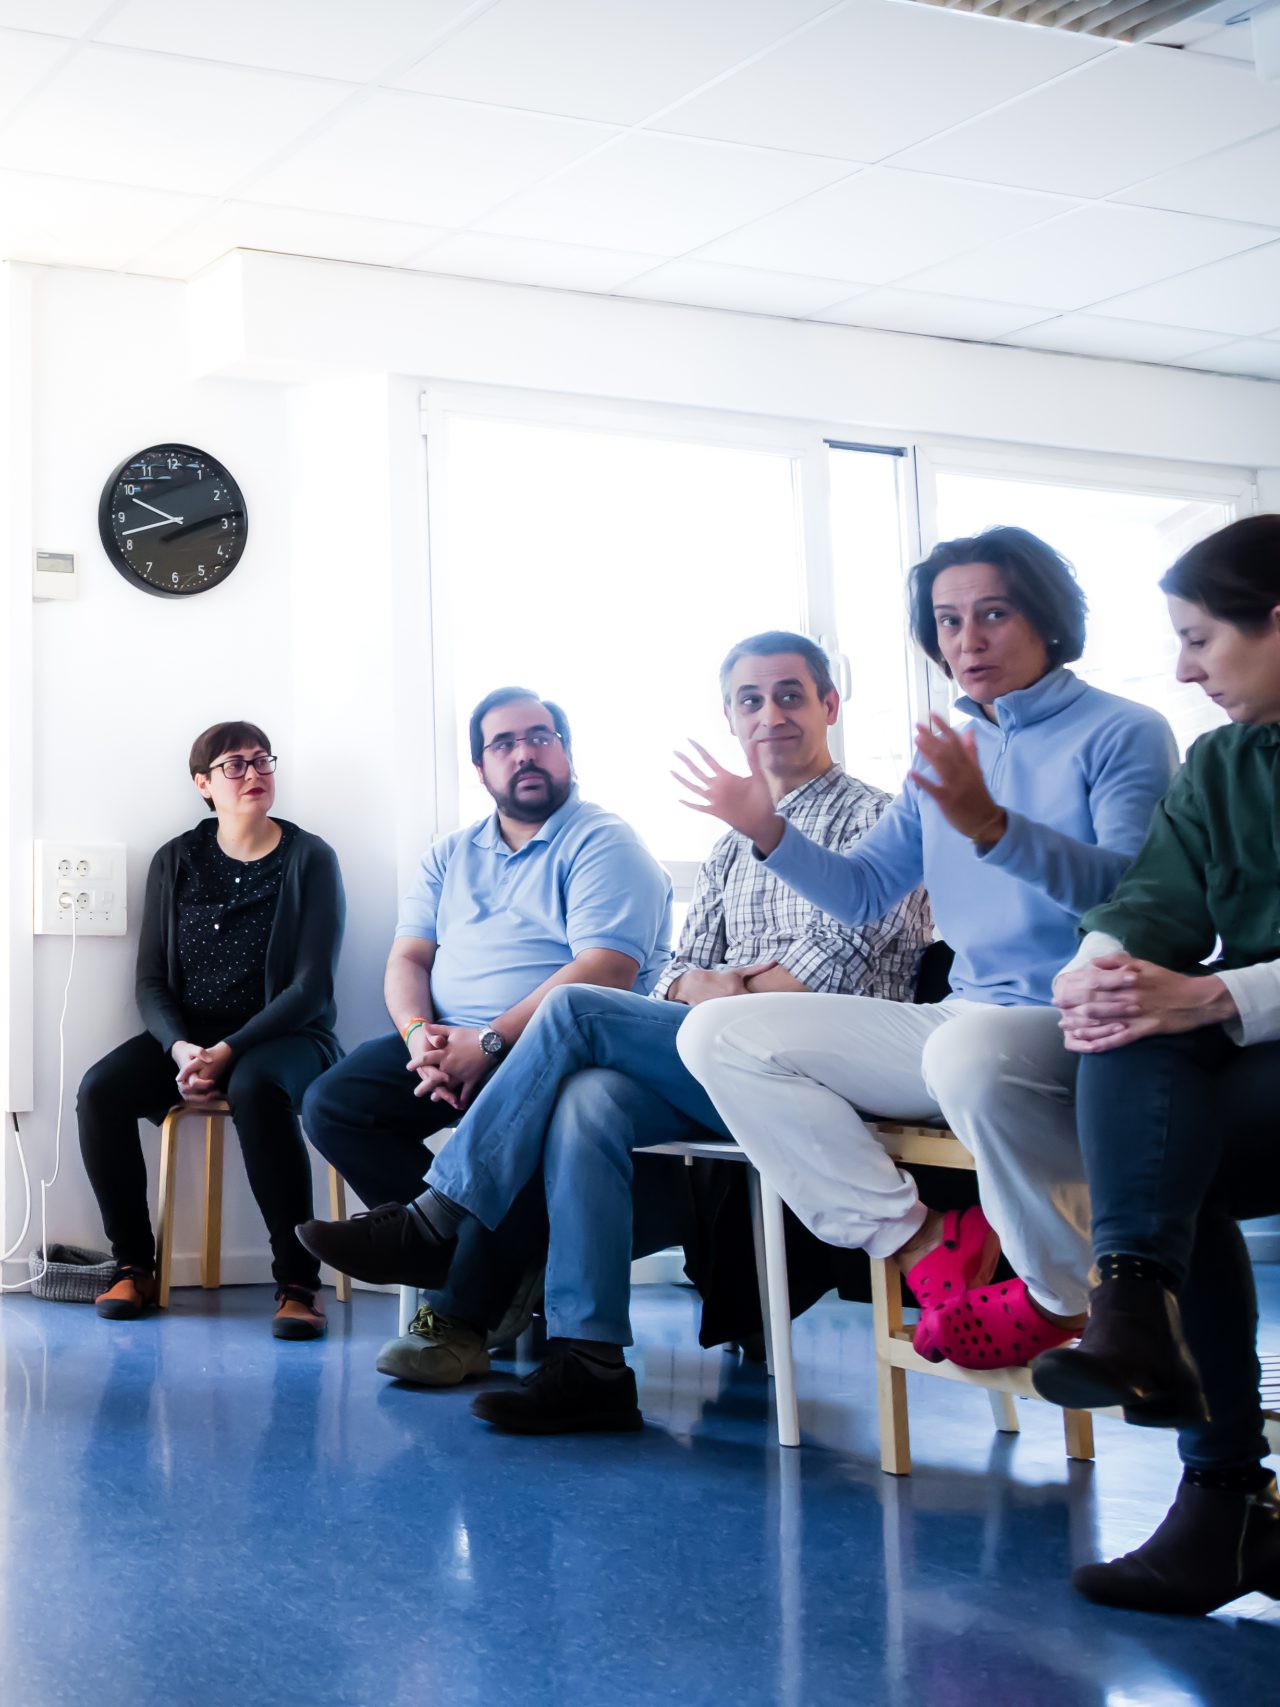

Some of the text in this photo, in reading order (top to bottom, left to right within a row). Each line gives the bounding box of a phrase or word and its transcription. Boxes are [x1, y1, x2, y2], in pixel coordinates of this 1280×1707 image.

[167, 458, 178, 470] 12
[142, 466, 152, 477] 11
[196, 470, 202, 480] 1
[123, 484, 135, 496] 10
[213, 490, 220, 501] 2
[118, 512, 125, 523] 9
[221, 518, 228, 529] 3
[126, 539, 133, 551] 8
[217, 545, 223, 556] 4
[145, 561, 153, 573] 7
[198, 565, 205, 576] 5
[171, 572, 179, 583] 6
